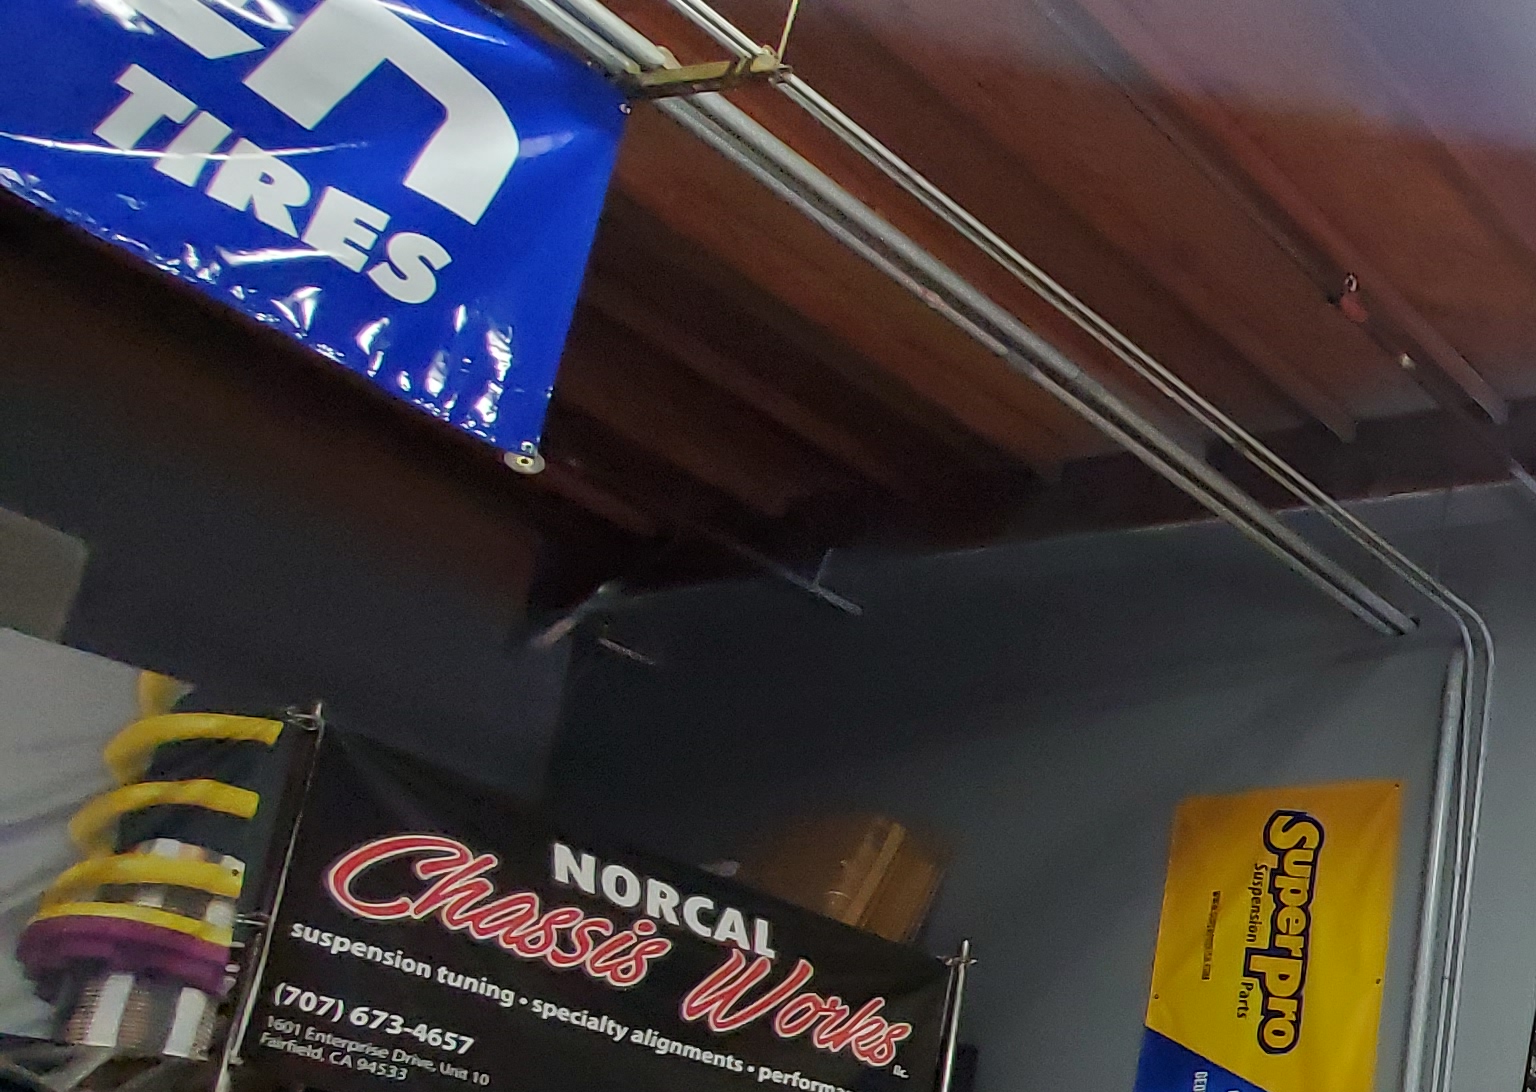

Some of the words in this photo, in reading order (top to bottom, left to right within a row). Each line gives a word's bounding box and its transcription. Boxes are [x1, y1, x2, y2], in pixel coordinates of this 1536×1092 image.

[94, 64, 452, 304] TIRES
[553, 842, 776, 959] NORCAL
[1244, 810, 1325, 1055] SuperPro
[1246, 863, 1268, 943] Suspension
[290, 922, 432, 979] suspension
[437, 966, 516, 1008] tuning
[531, 998, 630, 1041] specialty
[630, 1027, 743, 1073] alignments
[328, 834, 673, 988] Chassis
[681, 947, 912, 1067] Works
[273, 981, 345, 1023] (707)
[349, 1006, 475, 1055] 673-4657
[1236, 982, 1254, 1019] Parts
[304, 1026, 390, 1059] Enterprise
[440, 1062, 469, 1081] Unit
[472, 1071, 490, 1087] 10
[328, 1051, 353, 1068] CA
[356, 1057, 408, 1081] 94533
